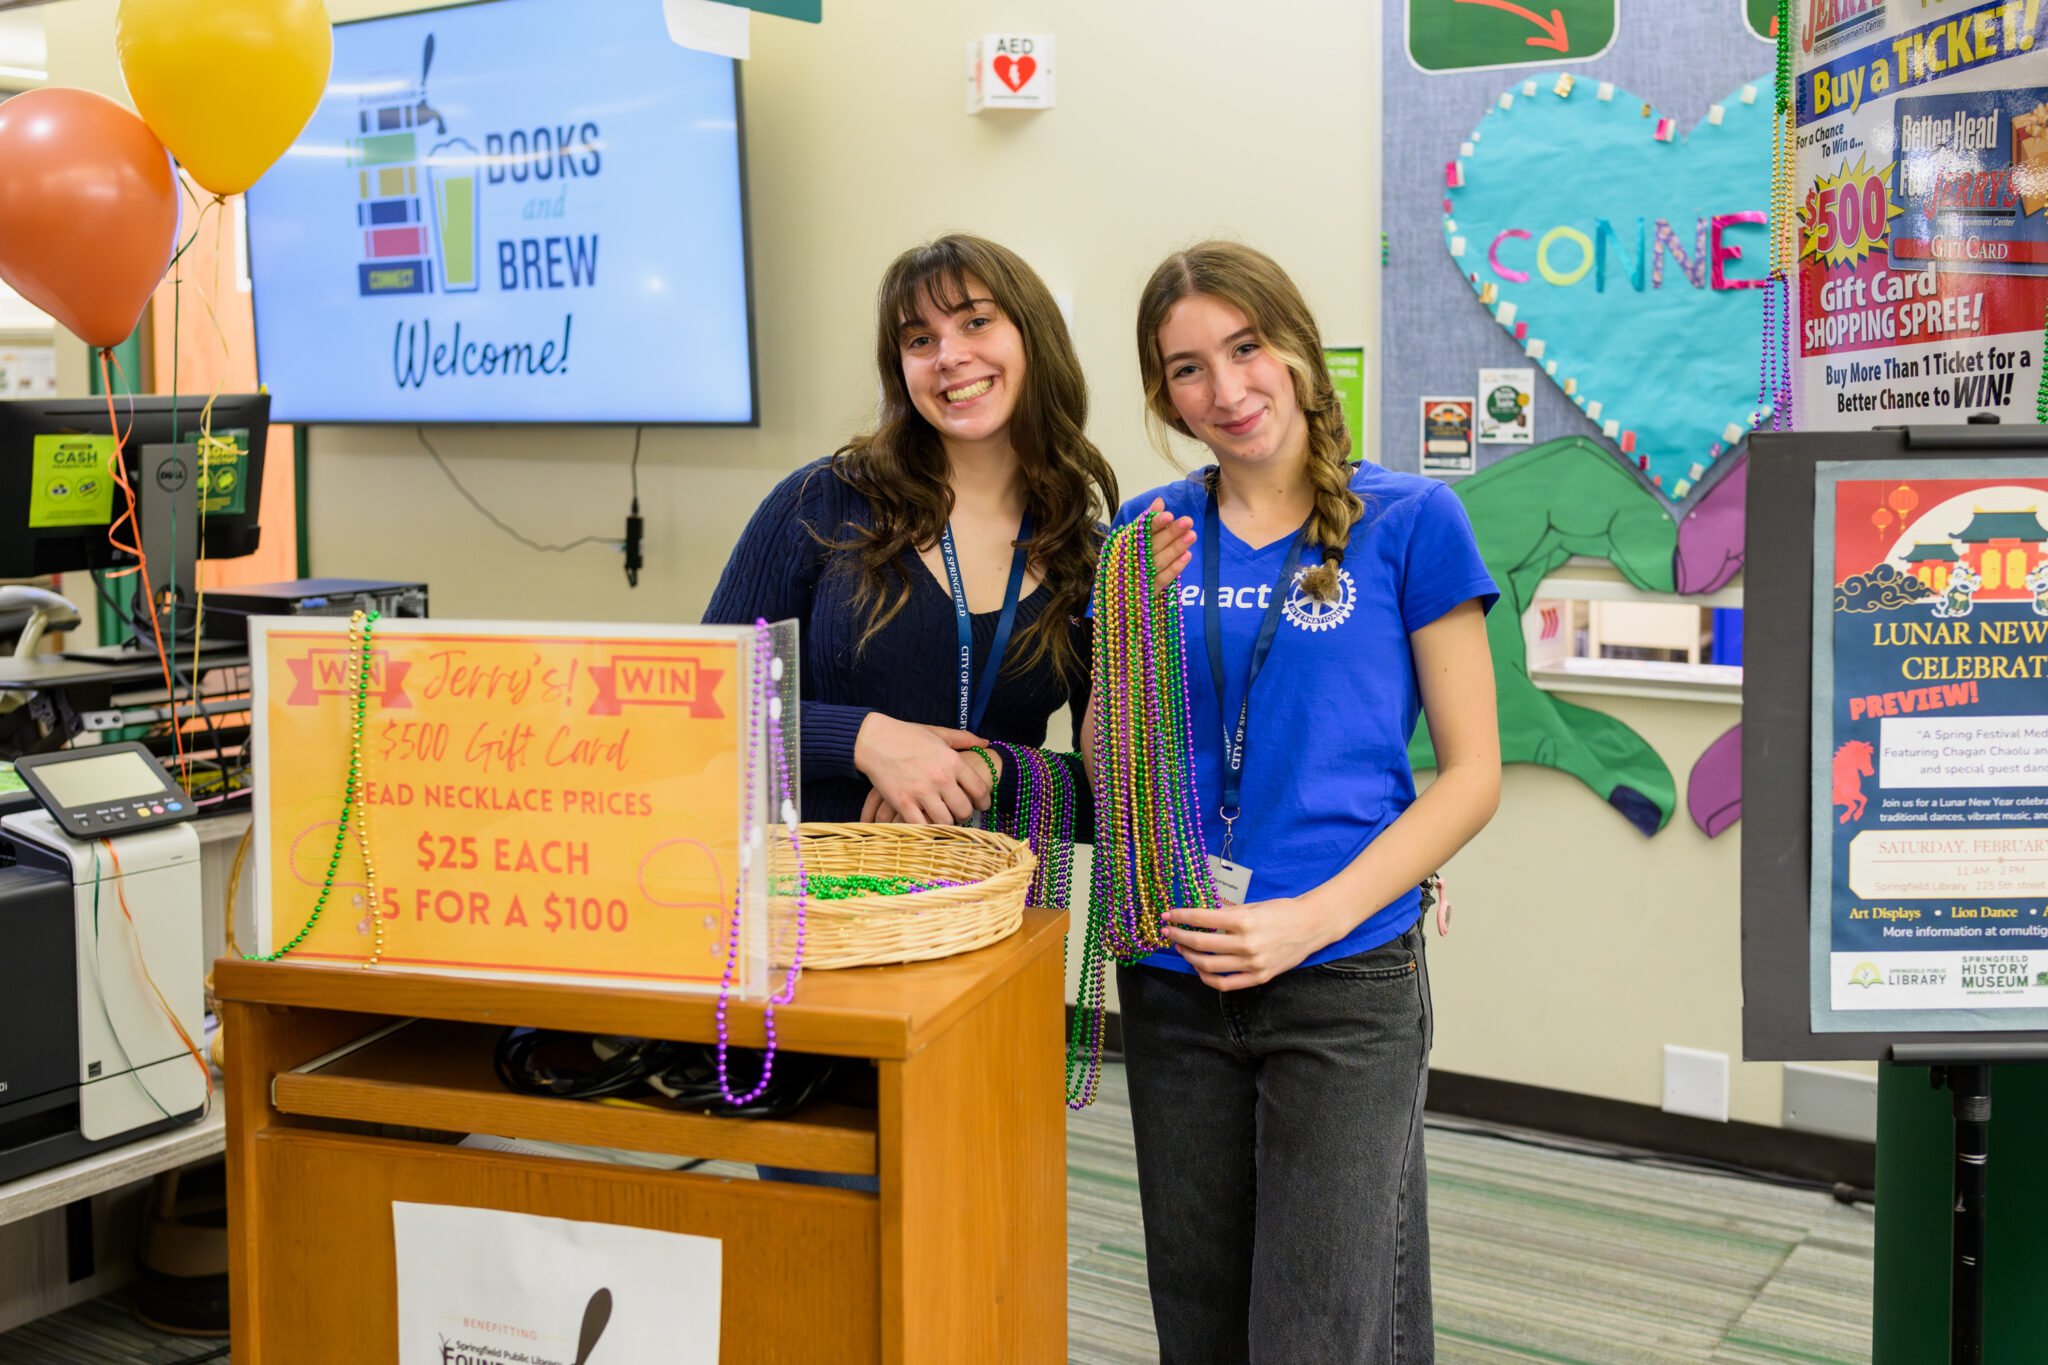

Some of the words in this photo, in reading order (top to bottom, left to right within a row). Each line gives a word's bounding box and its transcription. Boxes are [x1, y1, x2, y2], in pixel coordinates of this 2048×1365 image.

[1865, 17, 1886, 33] Center
[997, 38, 1034, 54] AED
[1813, 66, 1866, 114] Buy
[1870, 58, 1890, 93] a
[1892, 0, 2041, 84] TICKET!
[1809, 135, 1814, 146] a
[1815, 121, 1844, 142] Chance
[1953, 108, 1999, 150] Head
[486, 122, 602, 185] BOOKS
[1821, 143, 1832, 159] To
[1832, 138, 1848, 154] Win
[522, 184, 567, 220] and
[1805, 175, 1887, 253] $500
[1994, 217, 2015, 227] Center
[1966, 235, 2008, 260] CARD
[498, 233, 600, 291] BREW
[1820, 276, 1867, 312] Gift
[1871, 262, 1938, 303] Card
[1805, 306, 1896, 350] SHOPPING
[1899, 293, 1984, 337] SPREE!
[394, 313, 573, 389] Welcome!
[1826, 364, 1848, 388] Buy
[1850, 362, 1881, 383] More
[1884, 357, 1919, 380] Than
[1923, 354, 1930, 377] 1
[1933, 350, 1983, 375] Ticket
[1989, 347, 2016, 371] for
[2019, 350, 2031, 368] a
[1838, 393, 1877, 413] Better
[1880, 388, 1930, 410] Chance
[1933, 386, 1949, 408] to
[1954, 372, 2014, 409] WIN!
[54, 451, 97, 464] CASH
[943, 542, 953, 555] OF
[946, 556, 966, 617] SPRINGFIELD
[1873, 621, 1973, 646] LUNAR
[1979, 620, 2048, 645] NEW
[961, 645, 970, 669] CITY
[1902, 655, 2048, 680] CELEBRAT
[318, 659, 381, 686] WN
[423, 651, 578, 706] Jerry's!
[622, 667, 691, 696] WIN
[961, 671, 969, 691] OF
[1850, 681, 1979, 721] PREVIEW!
[379, 718, 449, 763] $500
[465, 722, 537, 773] Gift
[545, 725, 630, 771] Card
[1235, 726, 1244, 743] OF
[1935, 729, 1973, 741] Spring
[1976, 728, 2021, 740] Festival
[1231, 744, 1243, 770] CITY
[1884, 747, 1939, 758] Featuring
[1942, 746, 1986, 758] Chagan
[1990, 746, 2030, 757] Chaolu
[1920, 764, 1941, 774] and
[1944, 763, 1984, 775] special
[1988, 764, 2020, 776] guest
[353, 783, 414, 807] EAD
[425, 784, 553, 813] NECKLACE
[563, 790, 652, 817] PRICES
[1882, 799, 1900, 808] Join
[1902, 800, 1913, 808] us
[1916, 798, 1928, 808] for
[1939, 798, 1966, 808] Lunar
[1969, 798, 1990, 807] New
[1992, 797, 2013, 807] Year
[1880, 813, 1928, 822] traditional
[1967, 812, 2001, 821] vibrant
[417, 831, 479, 871] $25
[494, 838, 589, 876] EACH
[1879, 841, 1968, 855] SATURDAY,
[1973, 840, 2048, 853] FEBRUARY
[1972, 867, 1989, 875] AM
[1999, 867, 2006, 875] 2
[2009, 866, 2025, 875] PM
[1875, 881, 1930, 891] Springfield
[1932, 881, 1967, 892] Library
[1976, 881, 1995, 890] 225
[1998, 881, 2014, 889] 5th
[2017, 880, 2046, 889] street
[382, 887, 400, 920] 5
[416, 889, 490, 926] FOR
[504, 894, 529, 928] A
[543, 892, 629, 933] $100
[1849, 908, 1869, 919] Art
[1872, 908, 1921, 921] Displays
[1951, 907, 1977, 918] Lion
[1980, 906, 2018, 918] Dance
[1883, 927, 1913, 937] More
[1915, 926, 1982, 936] information
[1985, 927, 1997, 936] at
[1888, 975, 1946, 986] LIBRARY
[1961, 964, 2029, 974] HISTORY
[1961, 976, 2029, 988] MUSEUM
[463, 1317, 538, 1341] BENEFITTING
[456, 1341, 502, 1356] Springfield
[503, 1349, 529, 1364] Public
